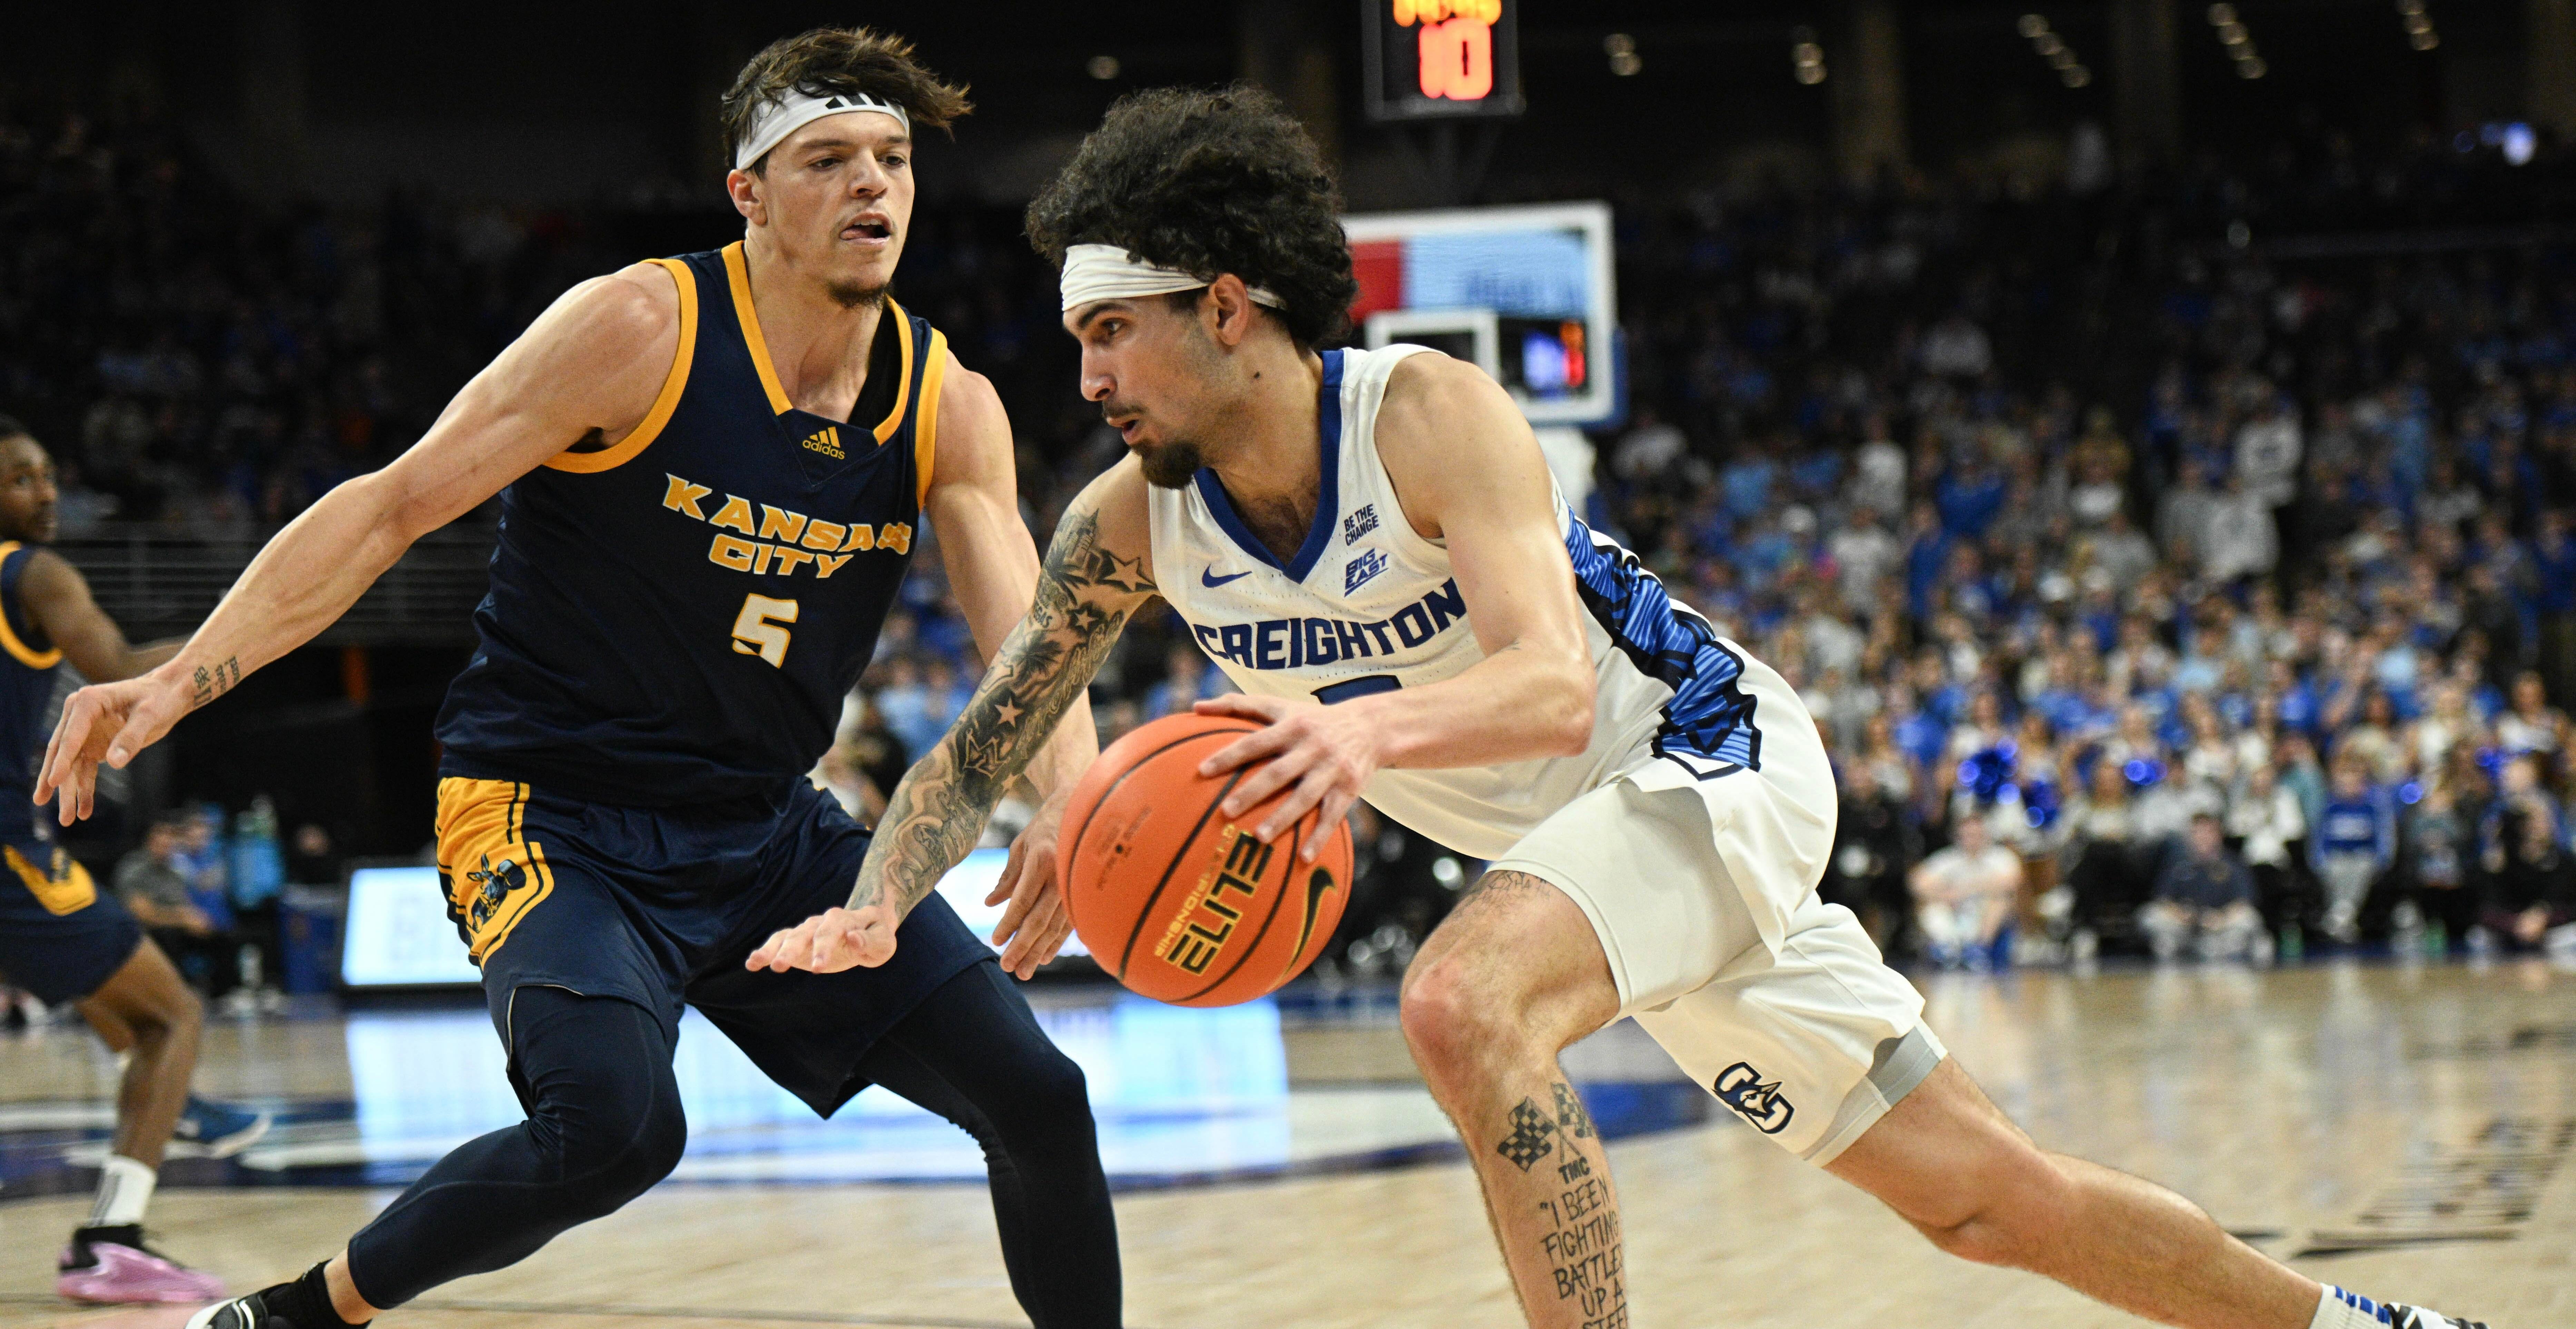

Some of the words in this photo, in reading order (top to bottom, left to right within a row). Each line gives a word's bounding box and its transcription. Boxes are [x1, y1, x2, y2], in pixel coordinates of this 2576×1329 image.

[1418, 17, 1493, 100] 10
[802, 438, 846, 460] adidas
[662, 472, 913, 555] KANSAS
[1344, 515, 1355, 532] BE
[1354, 503, 1374, 523] THE
[1345, 514, 1380, 546] CHANGE
[708, 533, 854, 579] CITY
[1345, 553, 1388, 591] EAST
[1346, 547, 1376, 577] BIG
[731, 593, 799, 670] 5
[1193, 577, 1467, 670] CREIGHTON
[1154, 823, 1235, 957] CHPIONSHIP
[1163, 831, 1275, 976] ELITE
[1558, 1156, 1590, 1184] TMC
[1562, 1173, 1611, 1221] BEEN
[1540, 1210, 1619, 1263] FIGHTING
[1552, 1243, 1622, 1300] BATTLE
[1581, 1287, 1606, 1317] UP
